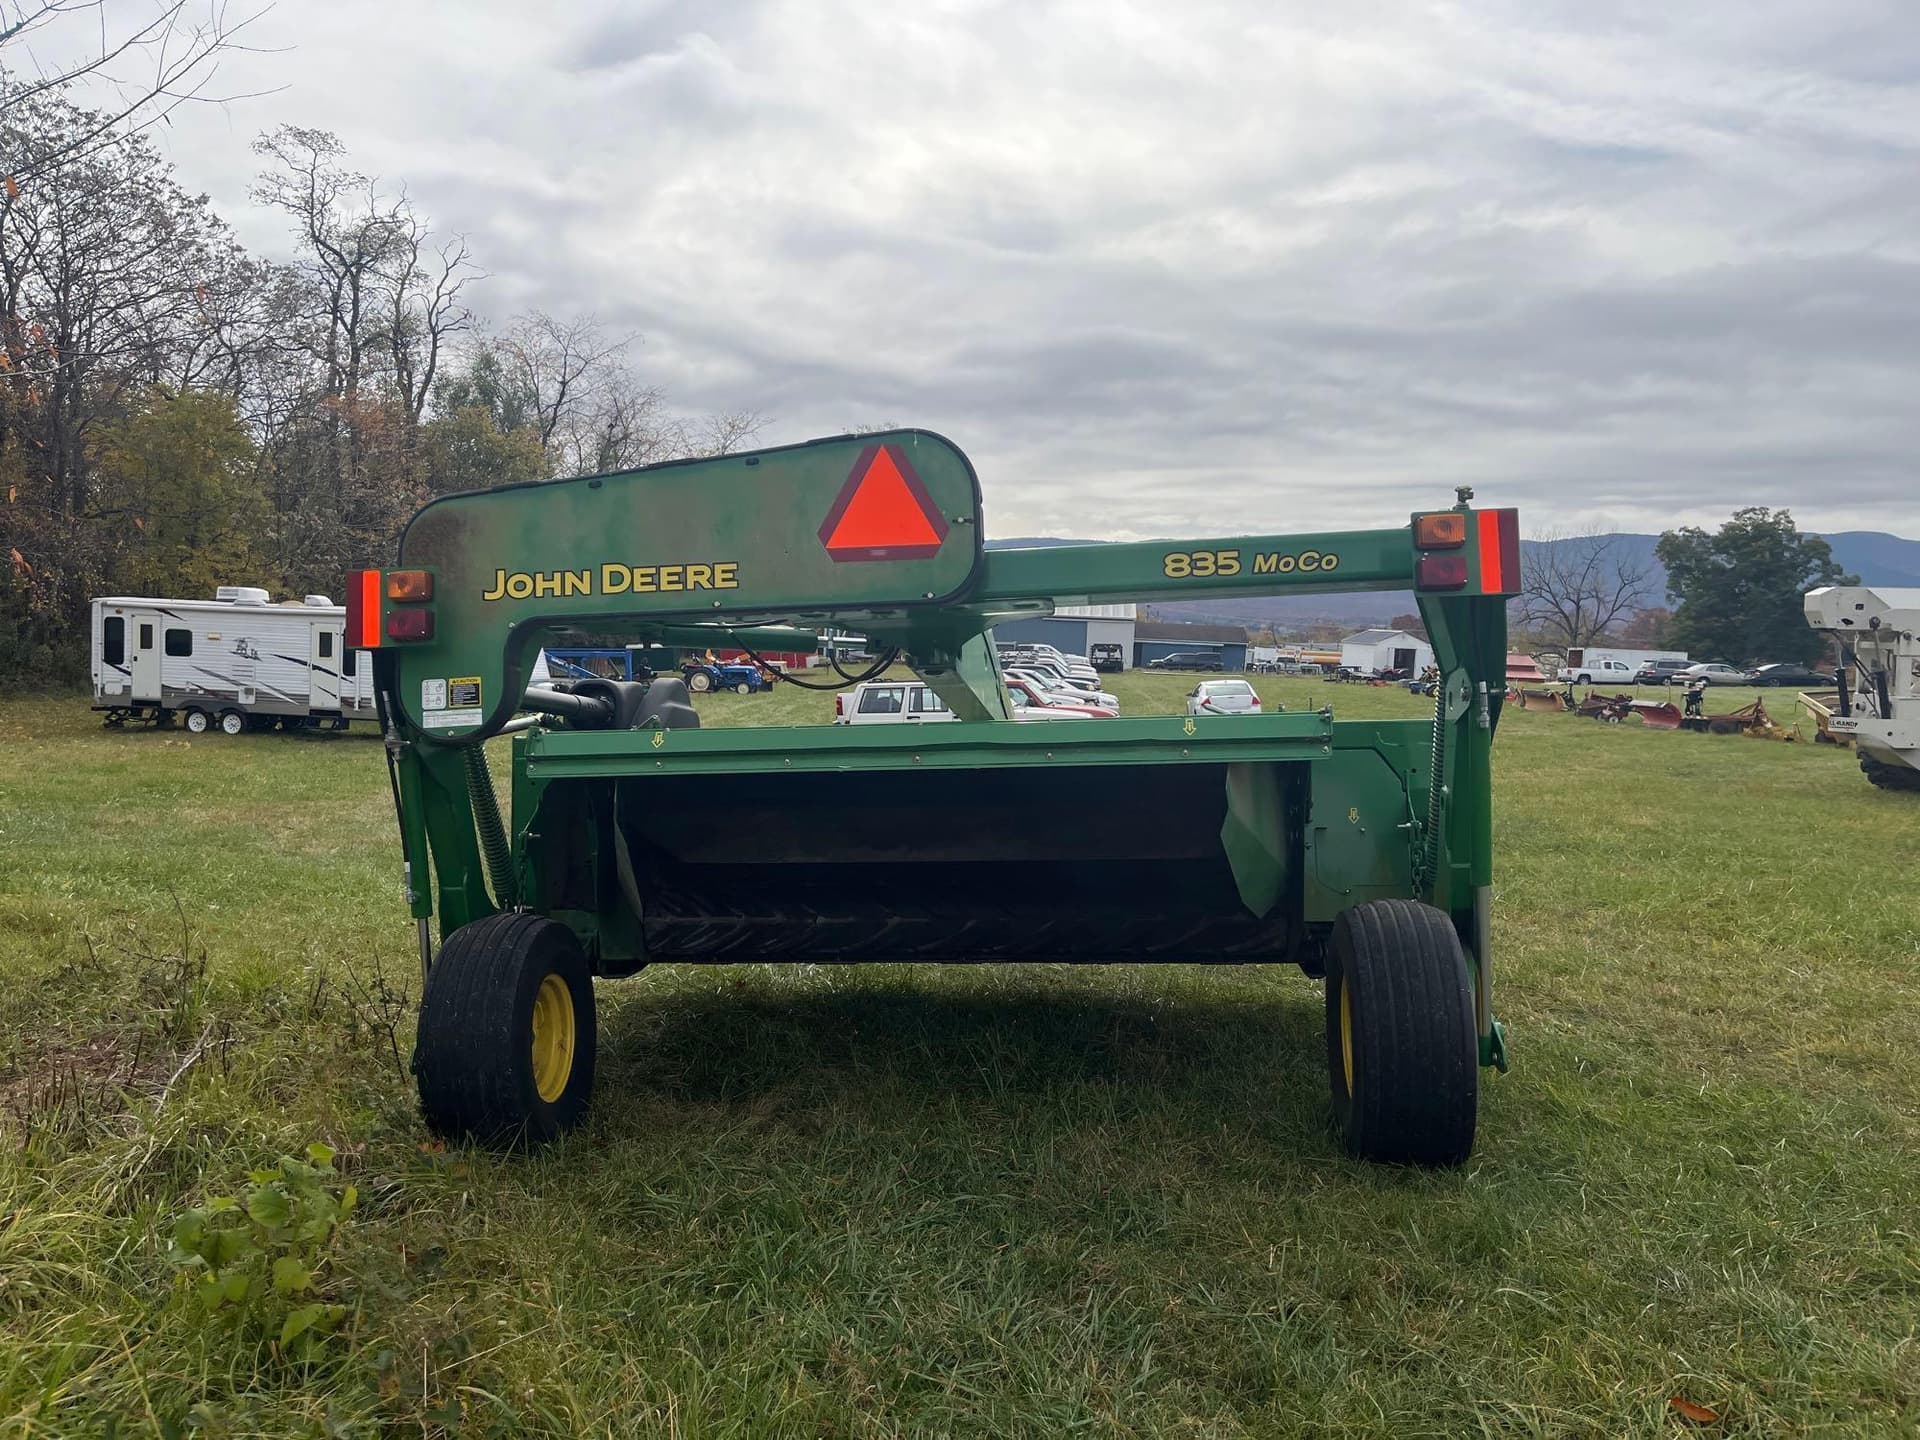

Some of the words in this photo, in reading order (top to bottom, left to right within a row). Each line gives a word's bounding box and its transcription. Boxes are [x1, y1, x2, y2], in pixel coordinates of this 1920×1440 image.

[1163, 549, 1241, 578] 835
[1252, 550, 1339, 575] MoCo
[483, 569, 592, 601] JOHN
[601, 562, 739, 595] DEERE
